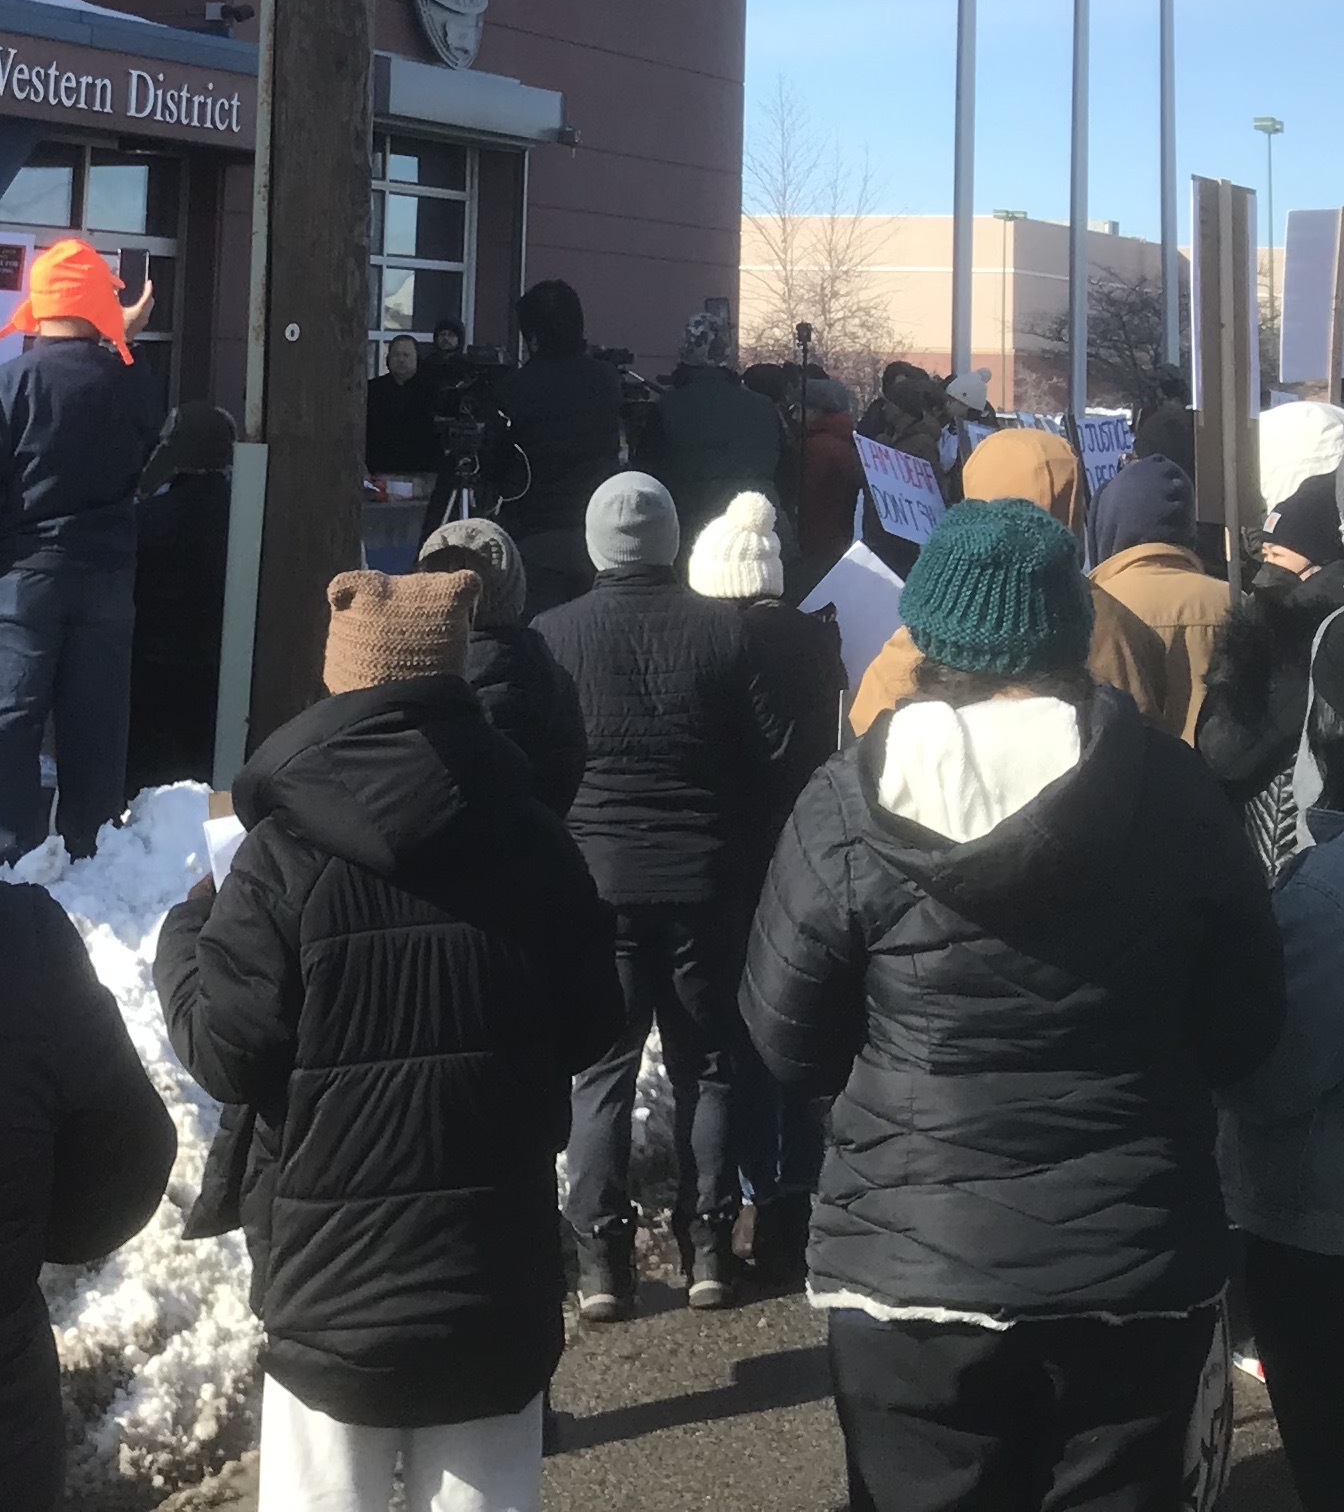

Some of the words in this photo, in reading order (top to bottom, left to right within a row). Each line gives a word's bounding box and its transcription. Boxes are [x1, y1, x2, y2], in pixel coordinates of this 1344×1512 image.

[126, 68, 242, 134] District
[1085, 418, 1132, 453] JUSTICE
[871, 484, 919, 531] DON'T
